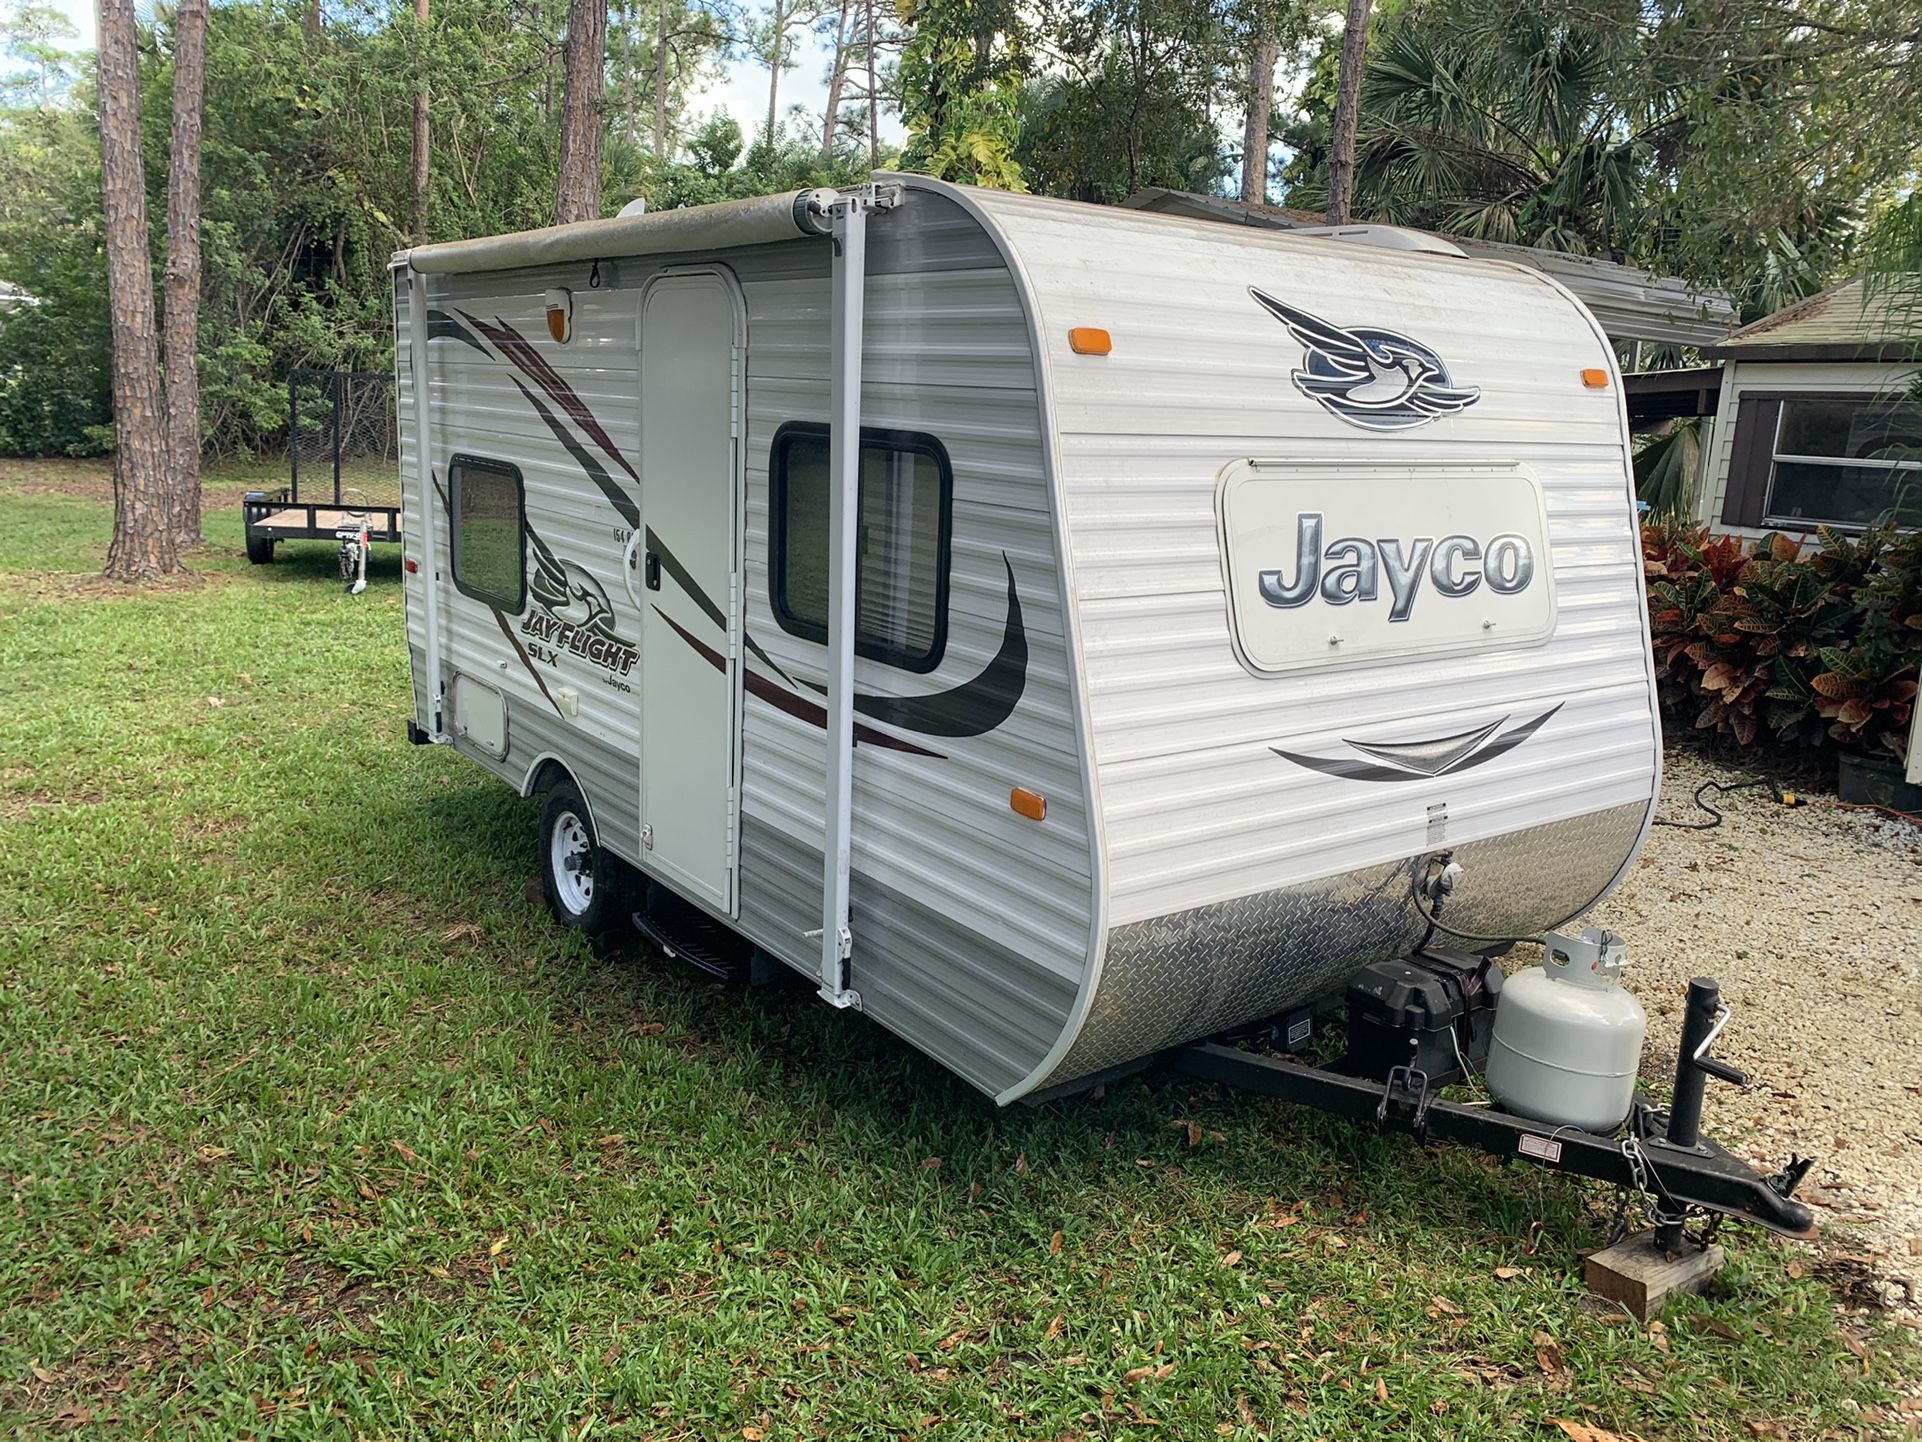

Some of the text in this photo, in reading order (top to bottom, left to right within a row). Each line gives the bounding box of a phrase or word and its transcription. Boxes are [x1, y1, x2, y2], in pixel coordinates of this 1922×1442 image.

[1258, 511, 1535, 623] Jayco
[521, 608, 640, 676] JAY FLIGHT
[528, 642, 558, 668] SLX
[608, 674, 631, 693] Jayco
